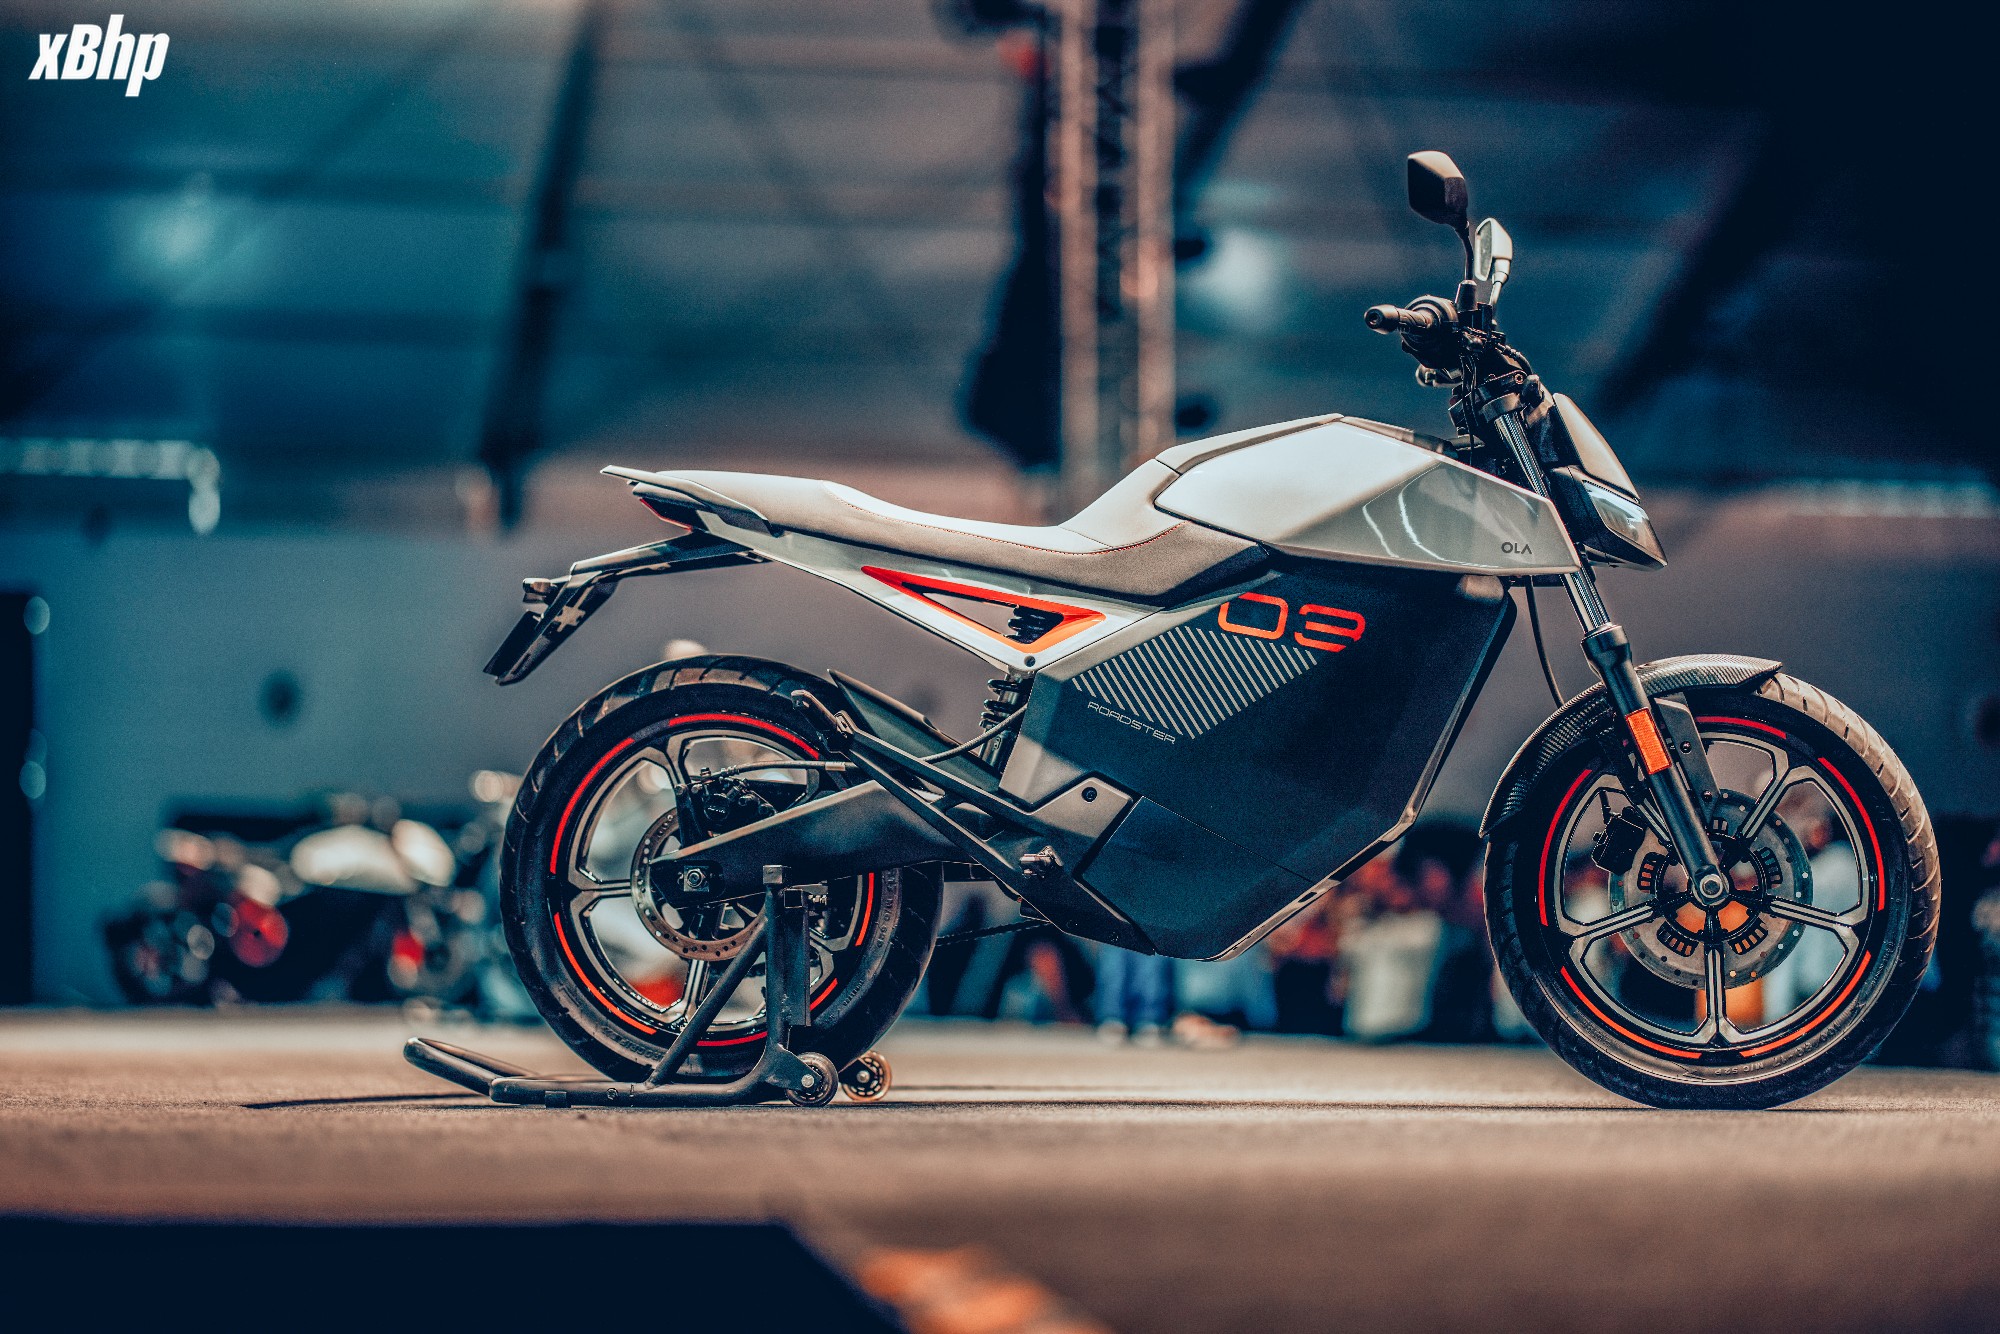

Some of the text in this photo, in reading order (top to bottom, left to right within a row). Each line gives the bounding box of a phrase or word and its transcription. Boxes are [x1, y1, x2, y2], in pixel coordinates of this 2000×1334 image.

[1501, 542, 1532, 554] OLA
[1217, 591, 1366, 652] 03
[1087, 700, 1176, 744] ROADSTER
